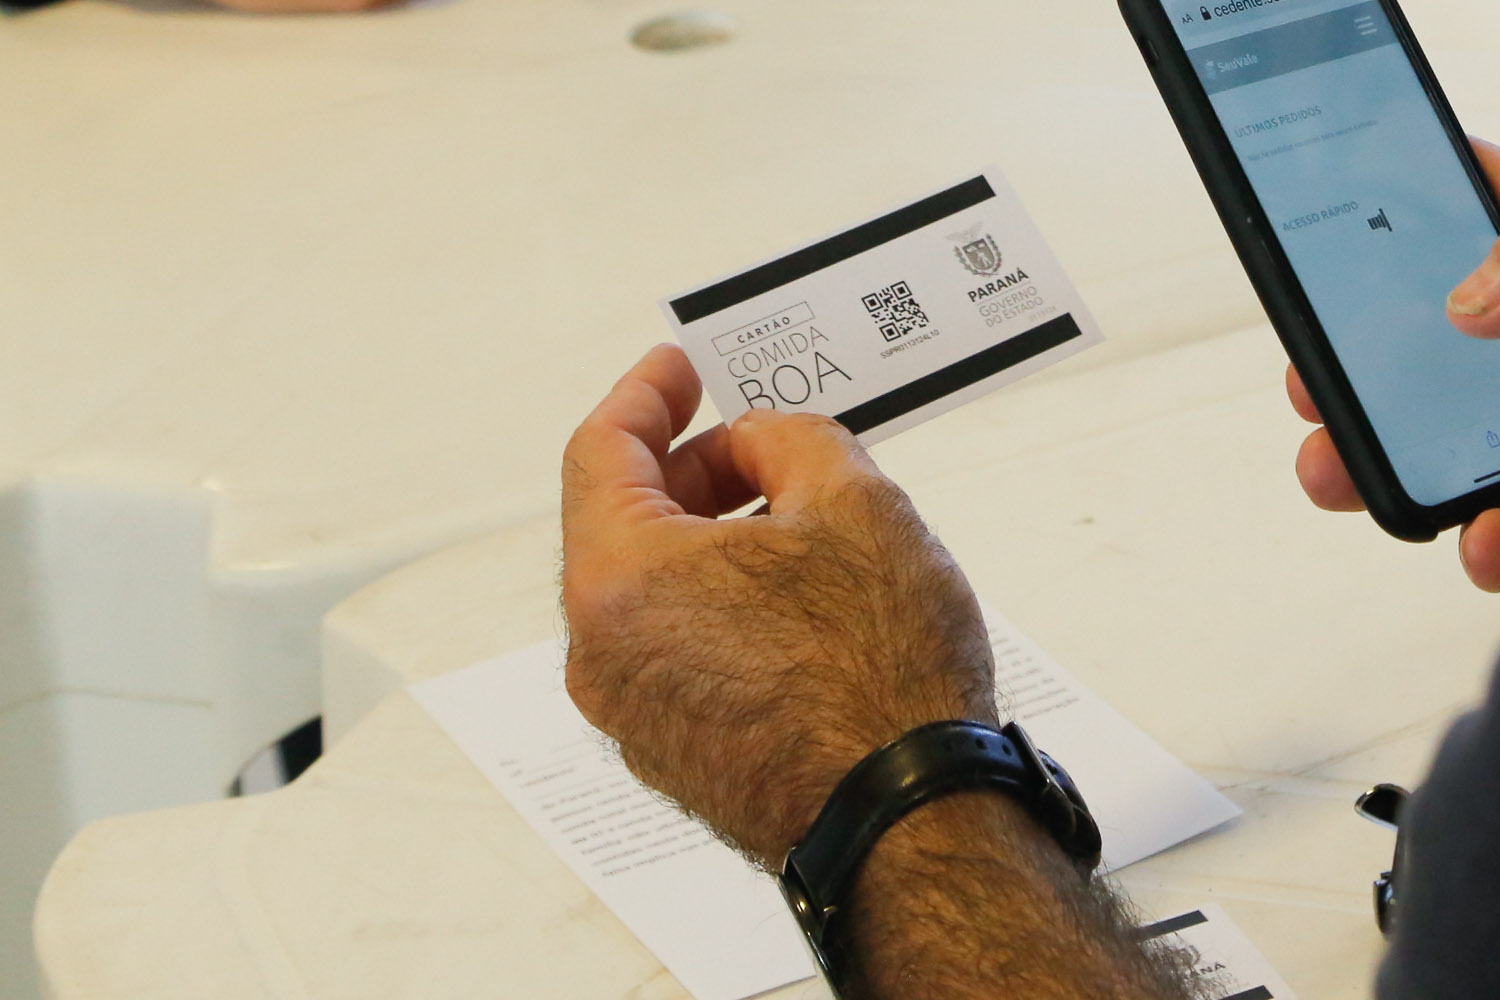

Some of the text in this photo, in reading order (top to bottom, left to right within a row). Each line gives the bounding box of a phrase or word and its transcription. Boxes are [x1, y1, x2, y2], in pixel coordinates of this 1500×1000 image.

[1279, 105, 1322, 126] PEDIDOS
[1282, 213, 1321, 231] ACESSO
[967, 266, 1030, 303] PARANÁ
[978, 286, 1038, 318] GOVERNO
[985, 312, 1003, 329] DO
[1003, 296, 1044, 322] ESTADO
[737, 315, 792, 345] CARTÃO
[727, 325, 829, 379] COMIDA
[738, 350, 853, 411] BOA
